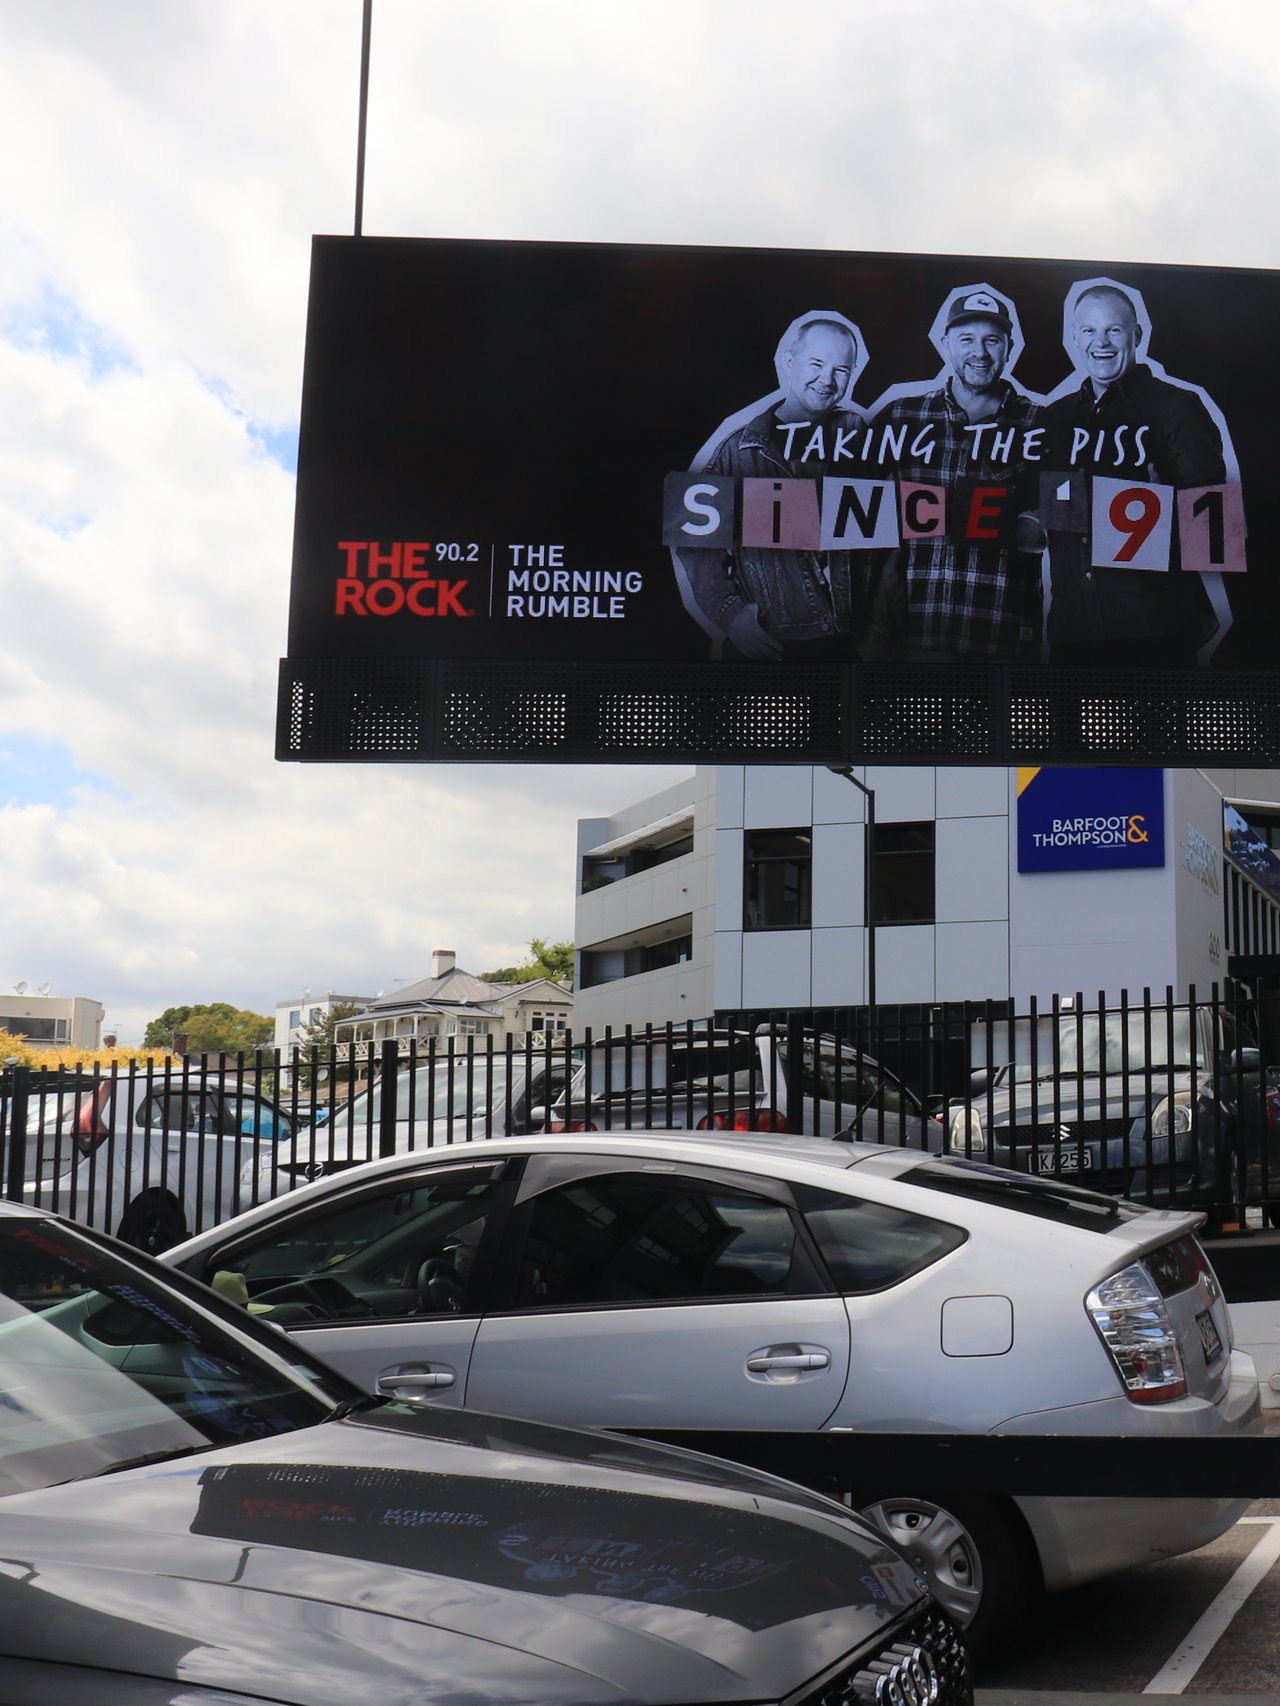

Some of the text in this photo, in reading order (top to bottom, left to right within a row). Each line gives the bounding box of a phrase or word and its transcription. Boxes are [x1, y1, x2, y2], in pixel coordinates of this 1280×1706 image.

[776, 421, 1150, 466] TAKING THE PISS
[337, 541, 479, 579] THE 90.2
[508, 544, 565, 567] THE
[507, 570, 643, 593] MORNING
[334, 578, 469, 617] ROCK
[507, 596, 626, 618] RUMBLE
[1032, 830, 1127, 847] THOMPSON
[1052, 815, 1149, 843] BARFOOT &
